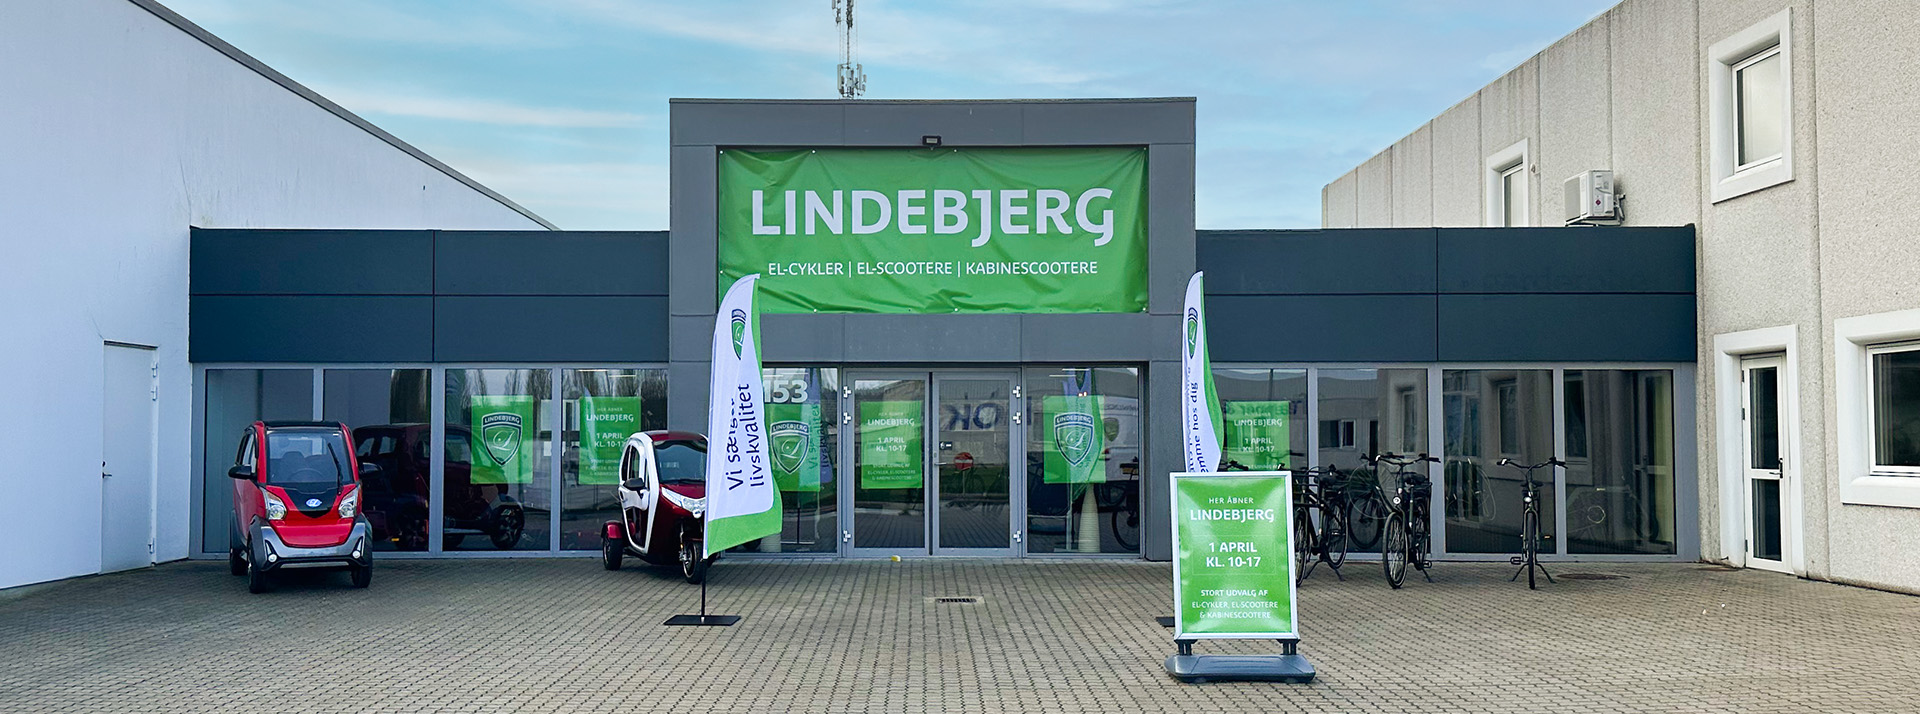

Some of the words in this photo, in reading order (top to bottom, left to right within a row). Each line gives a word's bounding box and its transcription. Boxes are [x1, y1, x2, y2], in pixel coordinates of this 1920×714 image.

[751, 188, 1114, 248] LINDEBJERG
[768, 262, 844, 276] EL-CYKLER
[857, 262, 953, 276] EL-SCOOTERE
[965, 261, 1098, 276] KABINESCOOTERE
[1190, 382, 1199, 403] dig
[484, 415, 520, 424] LINDEBJERG
[586, 413, 634, 422] LINDEBJERG
[867, 418, 915, 427] LINDEBJERG
[1234, 418, 1283, 427] LINDEBJERG
[772, 423, 808, 433] LINDEBJERG
[738, 383, 764, 487] livskvalitet
[725, 469, 744, 490] Vi
[1227, 496, 1254, 504] ÅBNER
[1190, 509, 1274, 523] LINDEBJERG
[1208, 542, 1215, 552] 1
[1219, 542, 1257, 552] APRIL
[1206, 556, 1225, 567] KL.
[1227, 556, 1261, 567] 10-17
[1200, 589, 1224, 597] STORT
[1225, 589, 1257, 597] UDVALG
[1258, 589, 1269, 597] AF
[1199, 611, 1205, 619] &
[1207, 611, 1271, 619] KABINESCOOTERE
